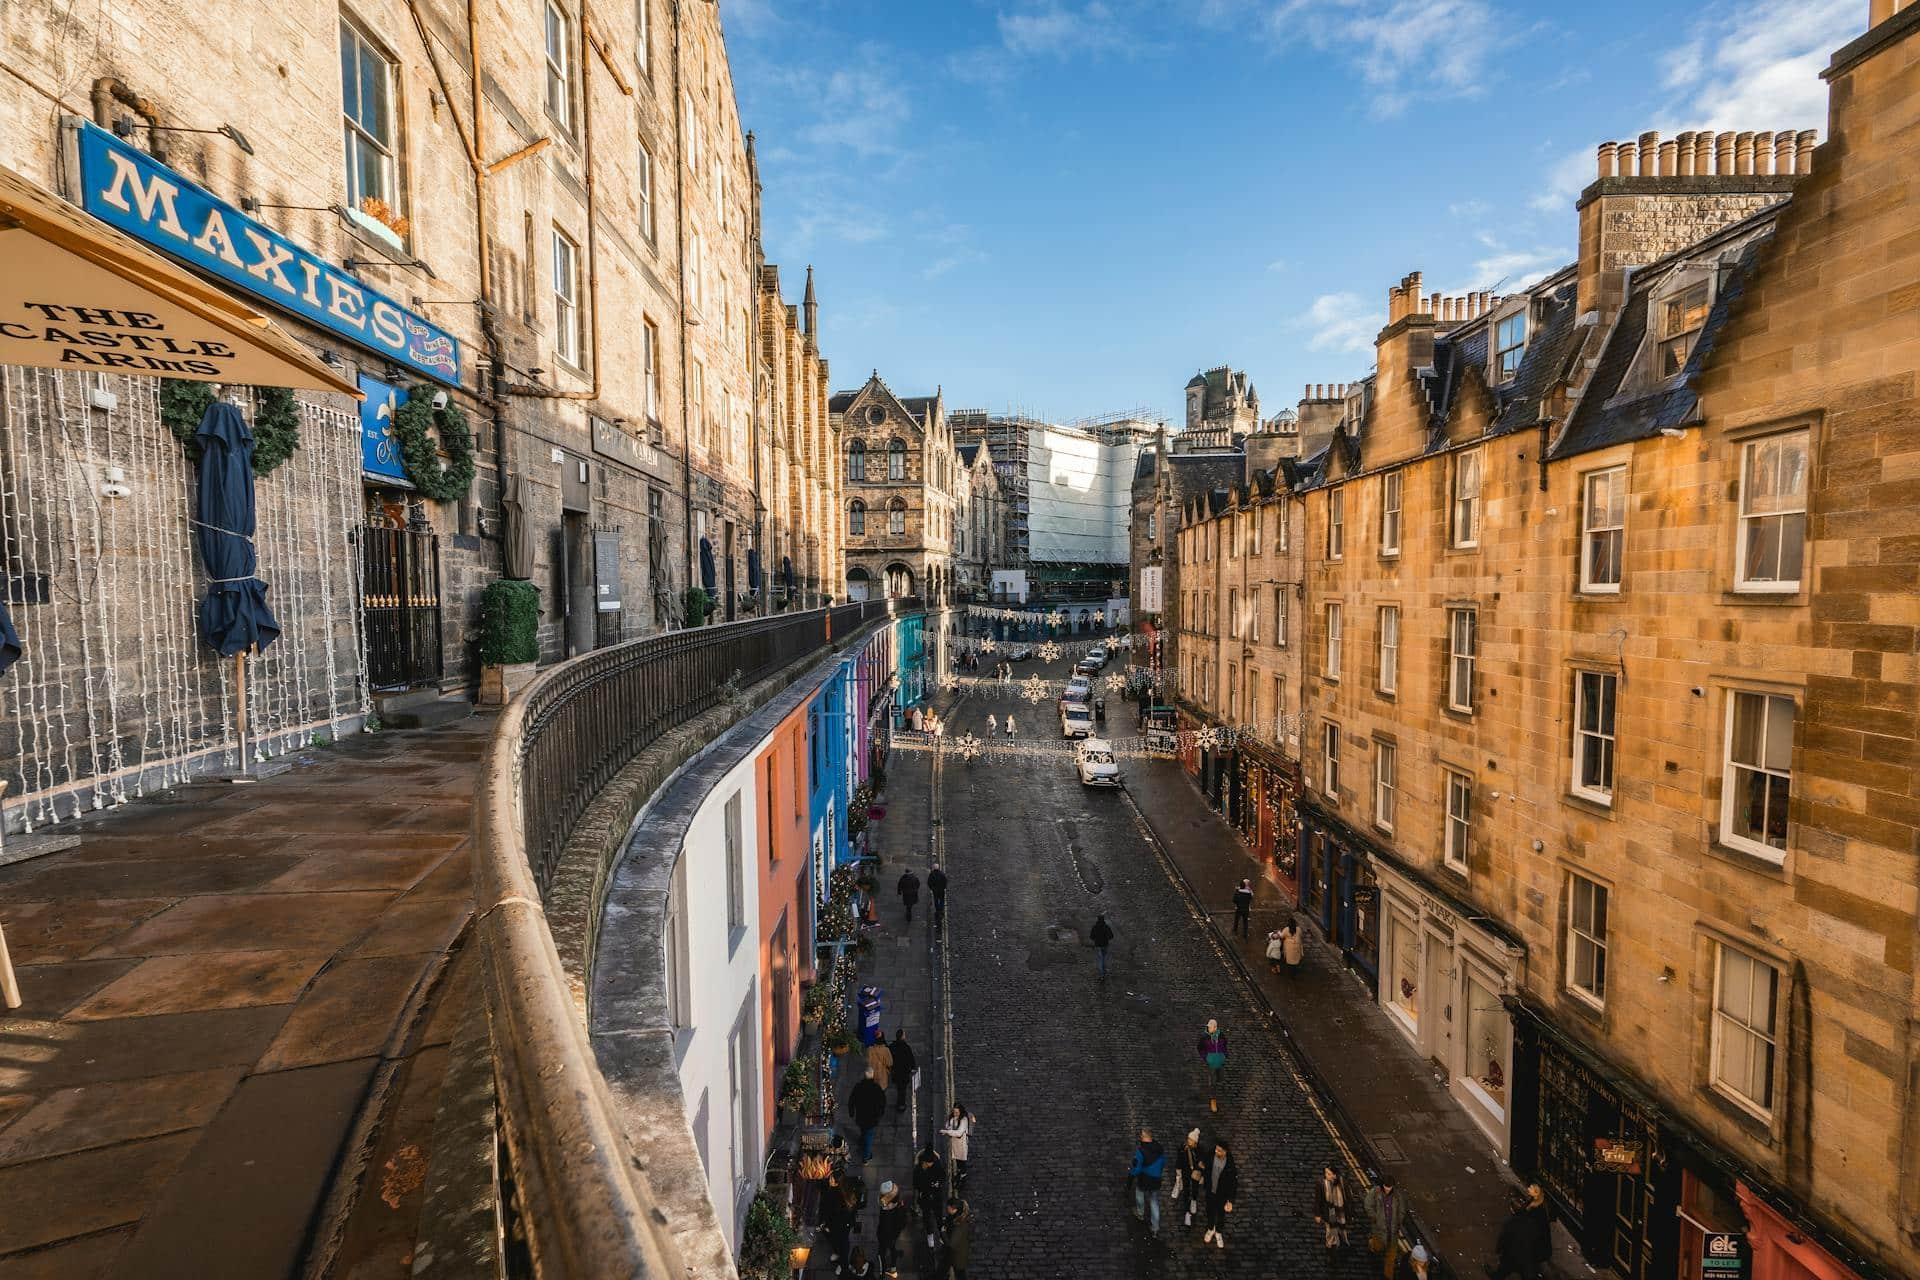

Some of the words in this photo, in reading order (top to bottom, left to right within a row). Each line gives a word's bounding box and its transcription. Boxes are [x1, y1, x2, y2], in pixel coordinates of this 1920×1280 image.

[102, 150, 405, 349] MAXIES
[24, 302, 164, 331] THE
[0, 322, 235, 358] CASTLE
